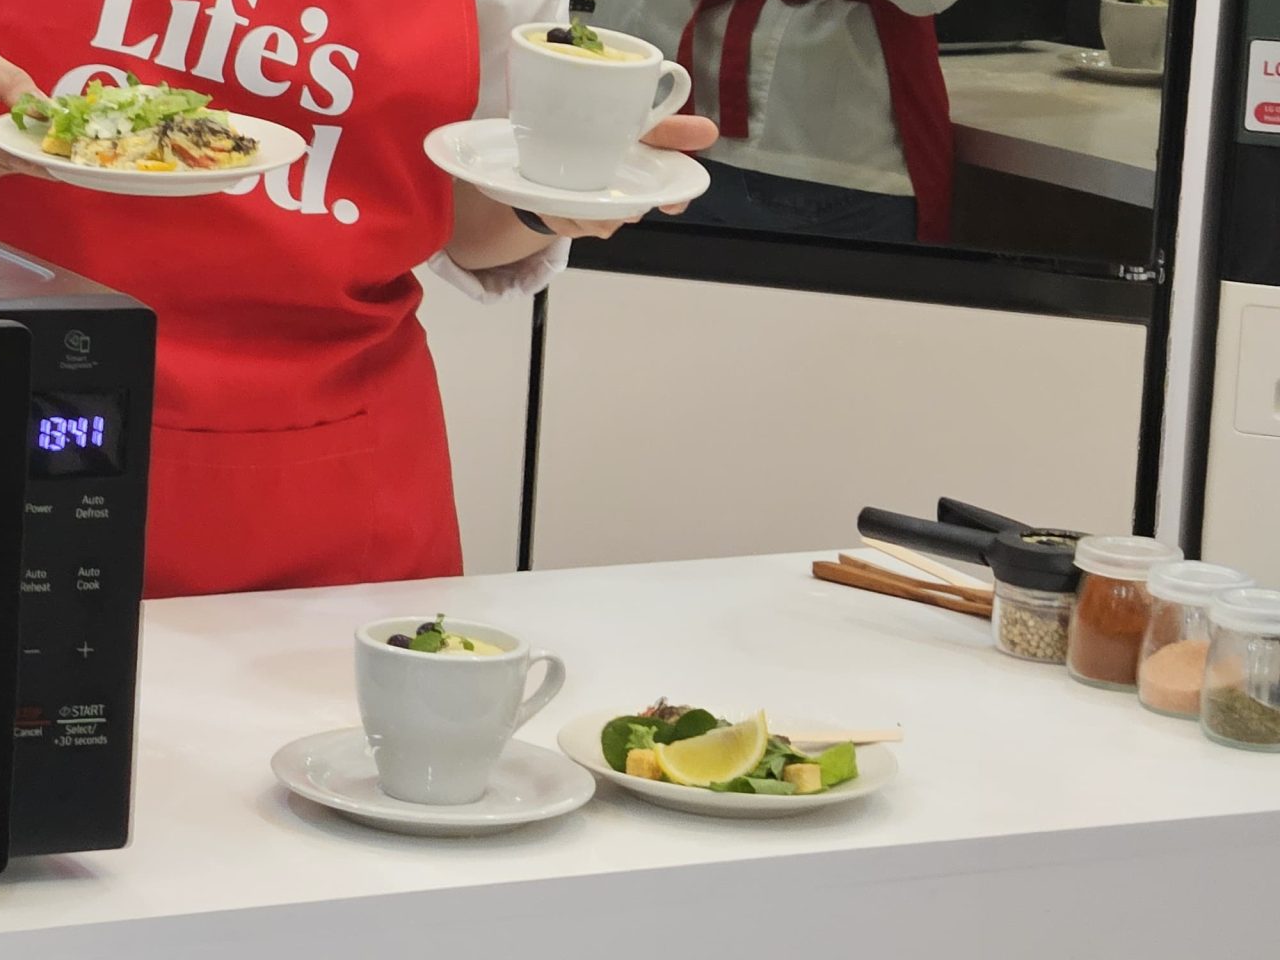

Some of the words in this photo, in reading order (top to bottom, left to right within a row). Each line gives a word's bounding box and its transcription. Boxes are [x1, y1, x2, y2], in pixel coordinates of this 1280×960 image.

[82, 494, 104, 505] Auto
[25, 503, 53, 513] Power
[75, 507, 109, 519] Defrost
[25, 569, 47, 579] Auto
[77, 567, 100, 577] Auto
[20, 581, 51, 593] Reheat
[76, 580, 100, 591] Cook
[71, 704, 105, 717] START
[14, 726, 43, 737] Cancel
[54, 736, 72, 746] +30
[74, 734, 108, 746] seconds
